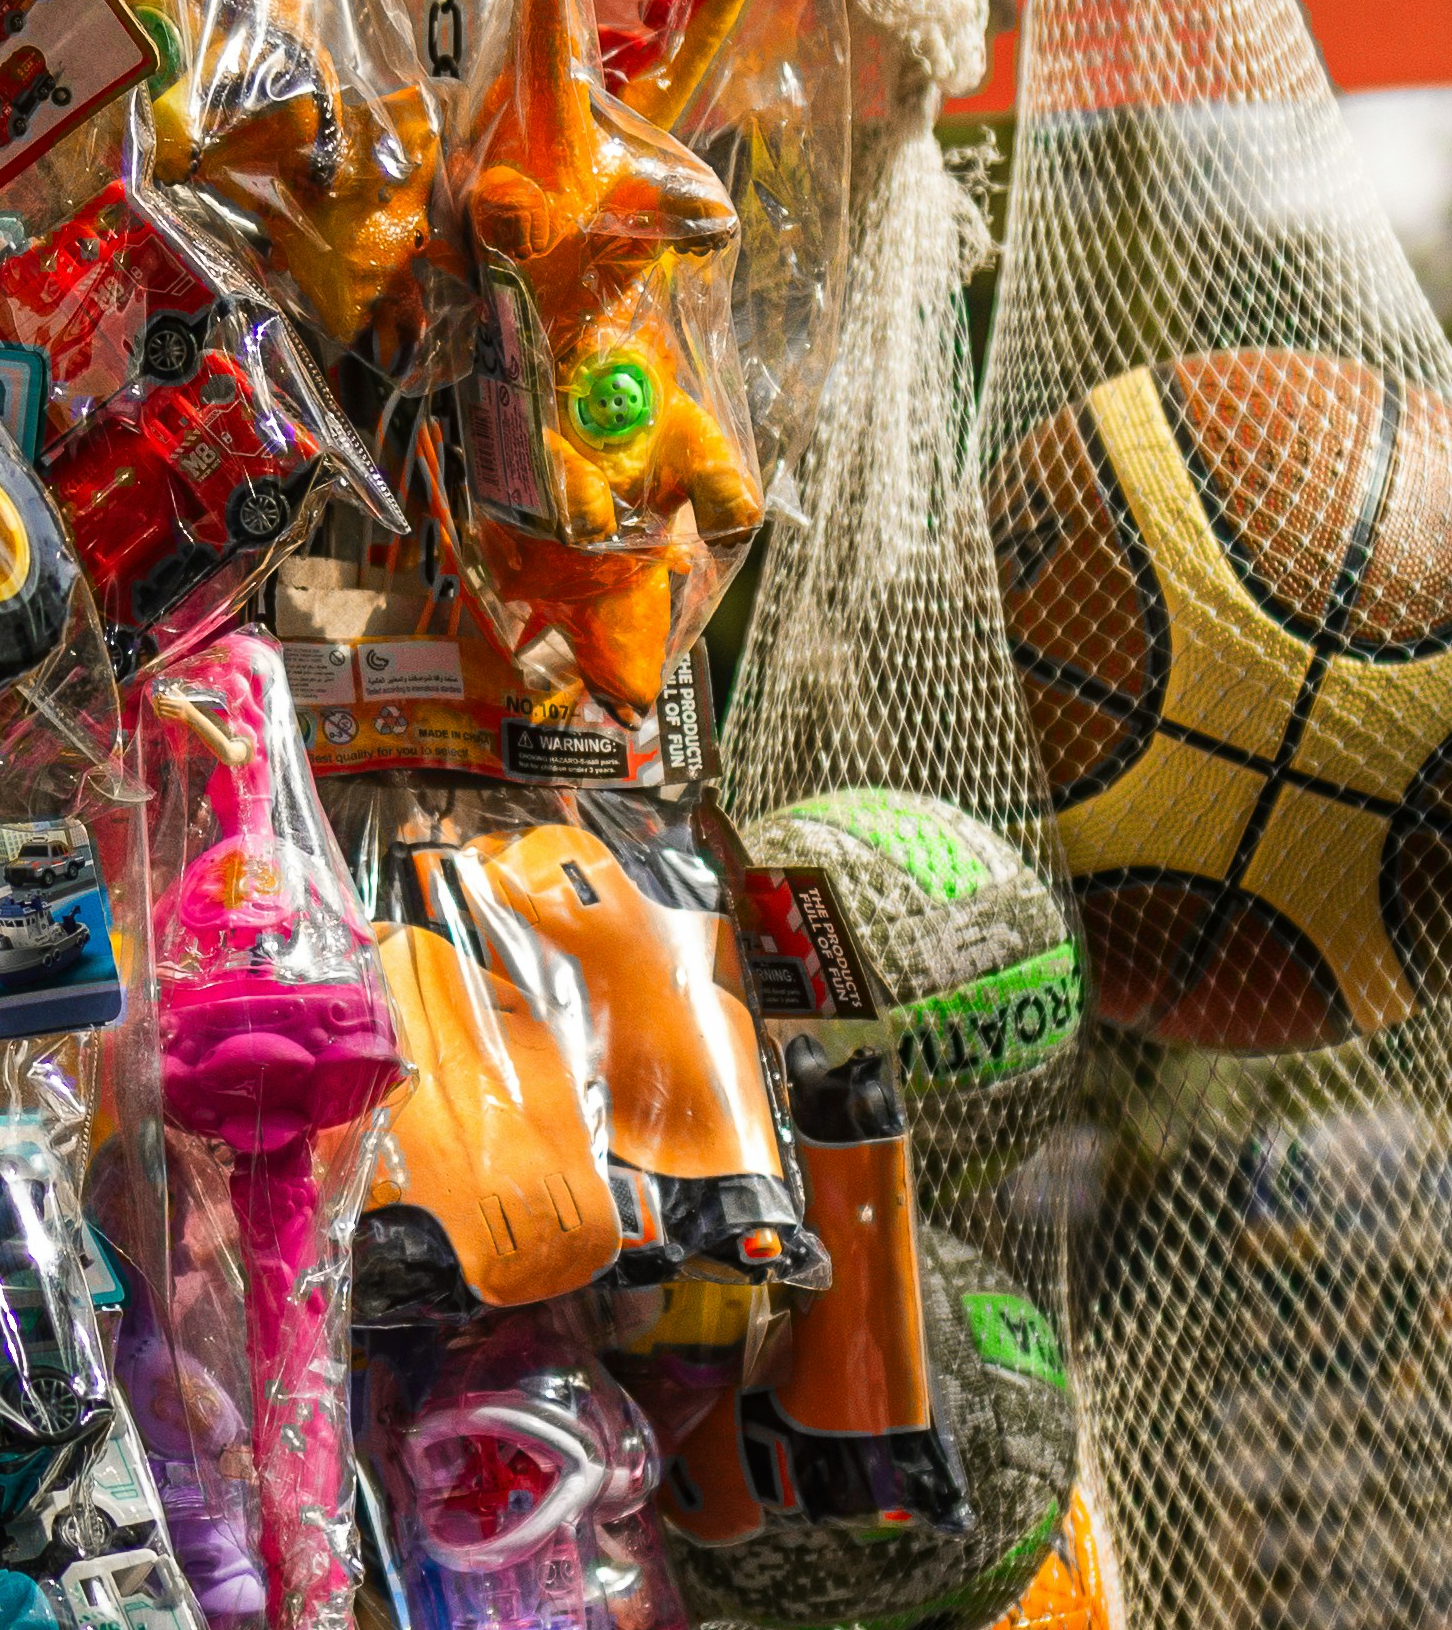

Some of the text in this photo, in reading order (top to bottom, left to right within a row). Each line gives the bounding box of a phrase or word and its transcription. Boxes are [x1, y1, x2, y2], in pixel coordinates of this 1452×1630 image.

[335, 748, 373, 764] quality
[377, 746, 393, 758] for
[396, 747, 418, 760] you
[421, 746, 433, 757] to
[418, 727, 449, 740] MADE
[451, 730, 462, 741] IN
[539, 735, 618, 754] WARNING:
[664, 702, 686, 769] OF FUN
[798, 892, 849, 1002] FULL OF FUN
[808, 887, 863, 1008] THE PRODUCTS
